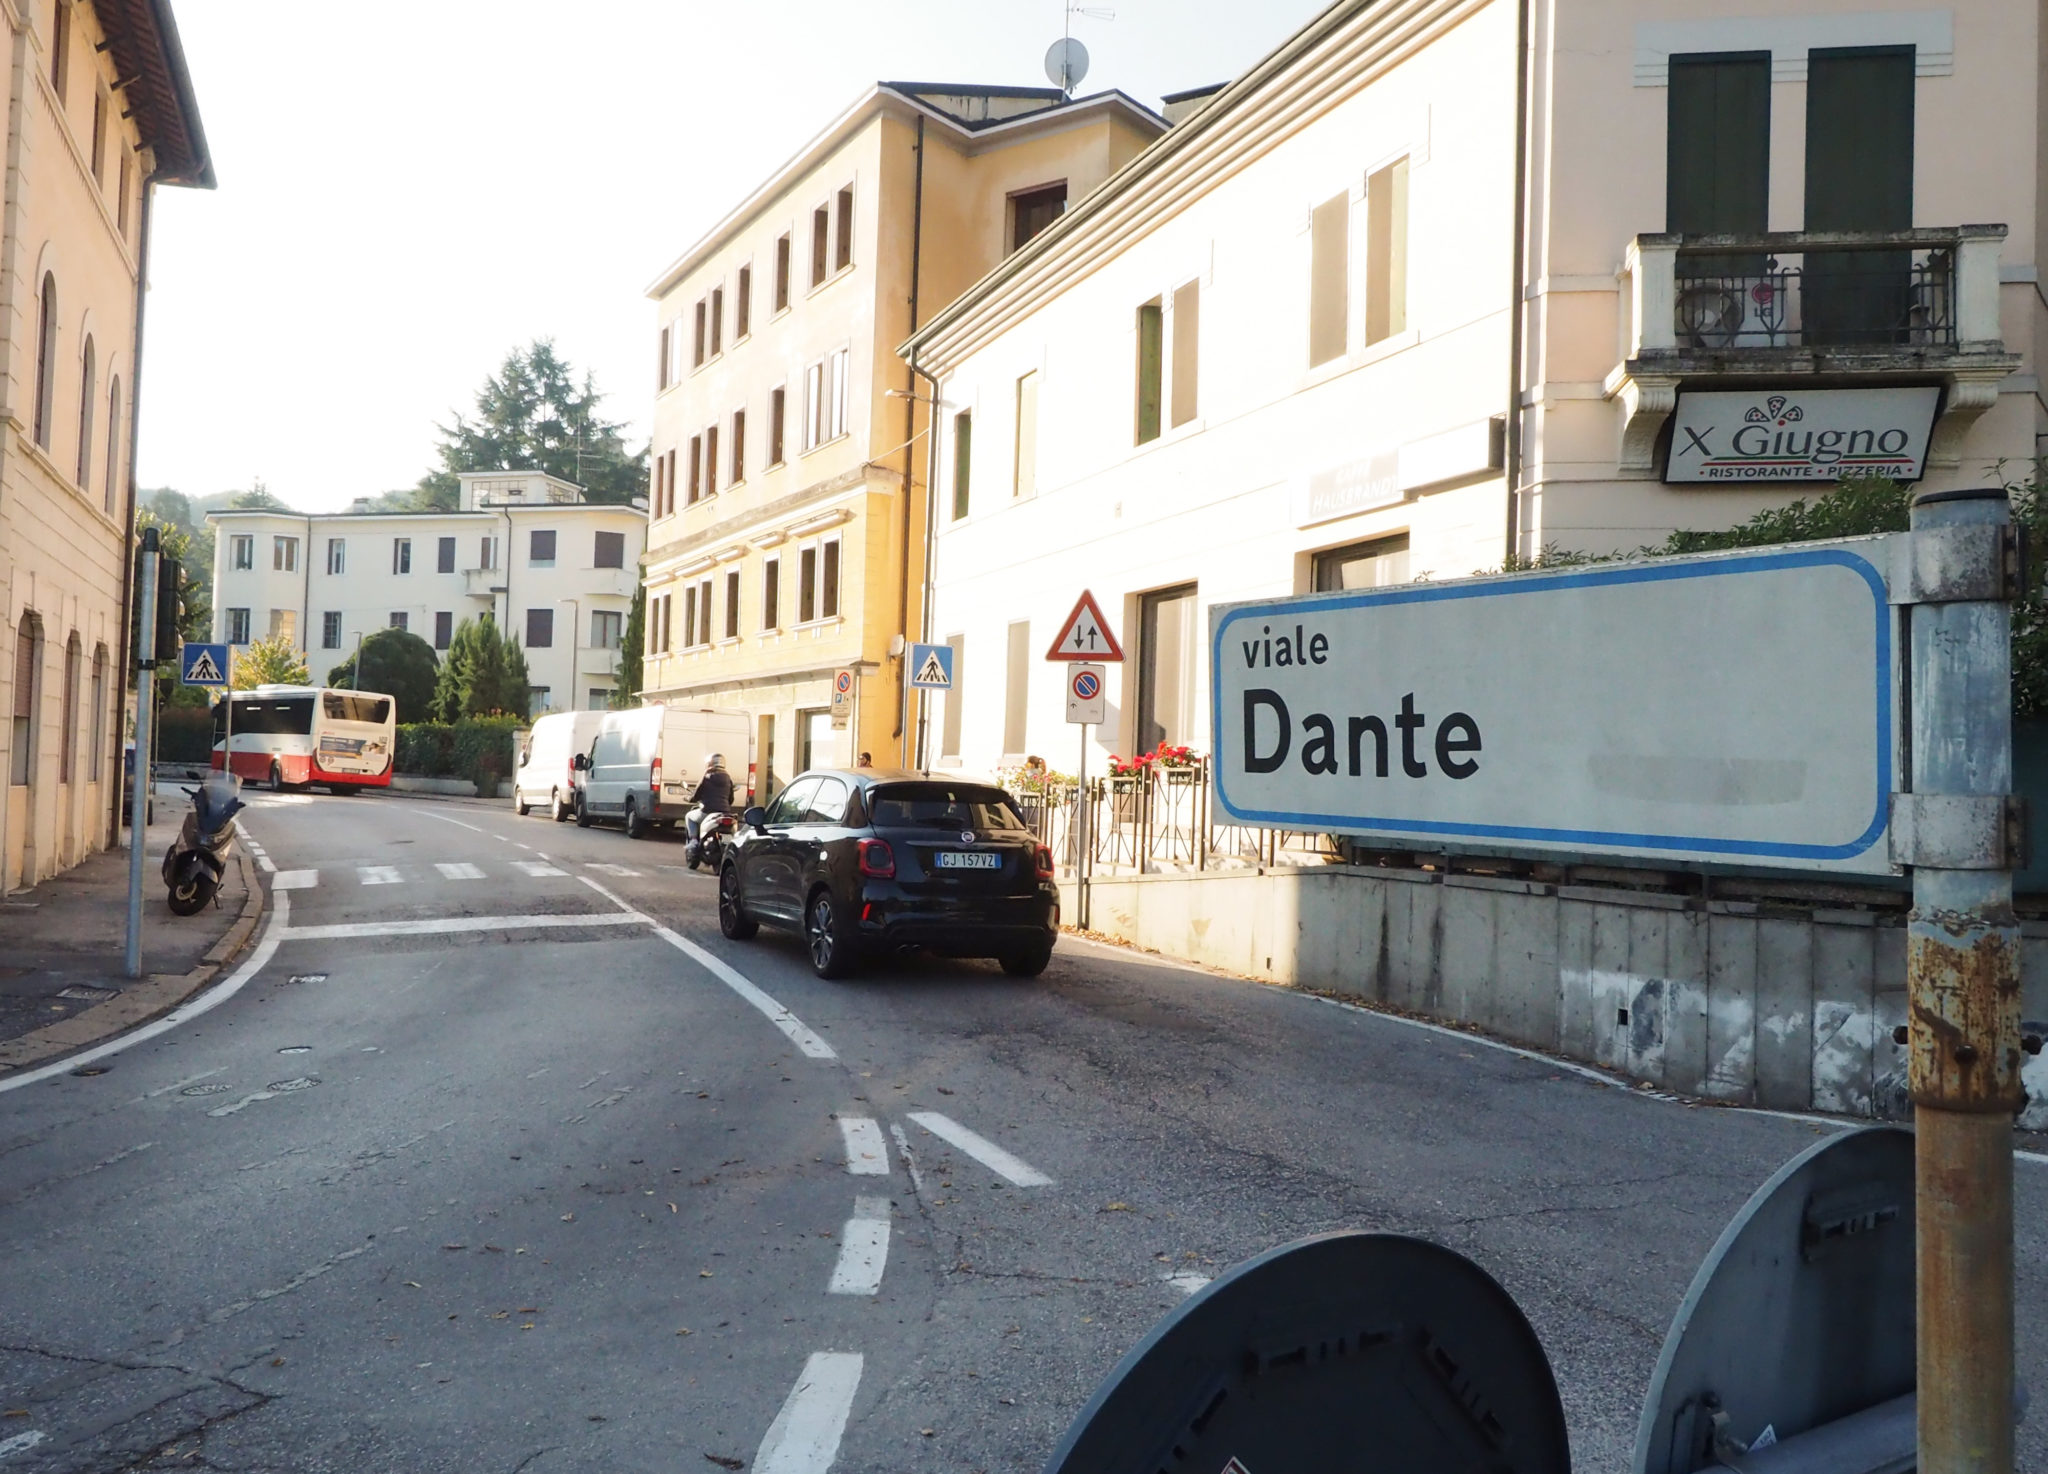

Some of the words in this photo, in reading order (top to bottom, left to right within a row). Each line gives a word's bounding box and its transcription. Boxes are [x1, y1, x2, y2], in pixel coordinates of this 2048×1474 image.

[1754, 307, 1773, 318] LG
[1678, 426, 1714, 457] X
[1732, 420, 1908, 464] Giugno
[1708, 466, 1812, 479] RISTORANTE
[1827, 465, 1902, 478] PIZZERIA
[1312, 475, 1398, 514] HAUSBRANDT
[1242, 625, 1329, 668] viale
[1243, 689, 1482, 779] Dante
[942, 854, 957, 866] GJ
[961, 854, 994, 867] 157VZ
